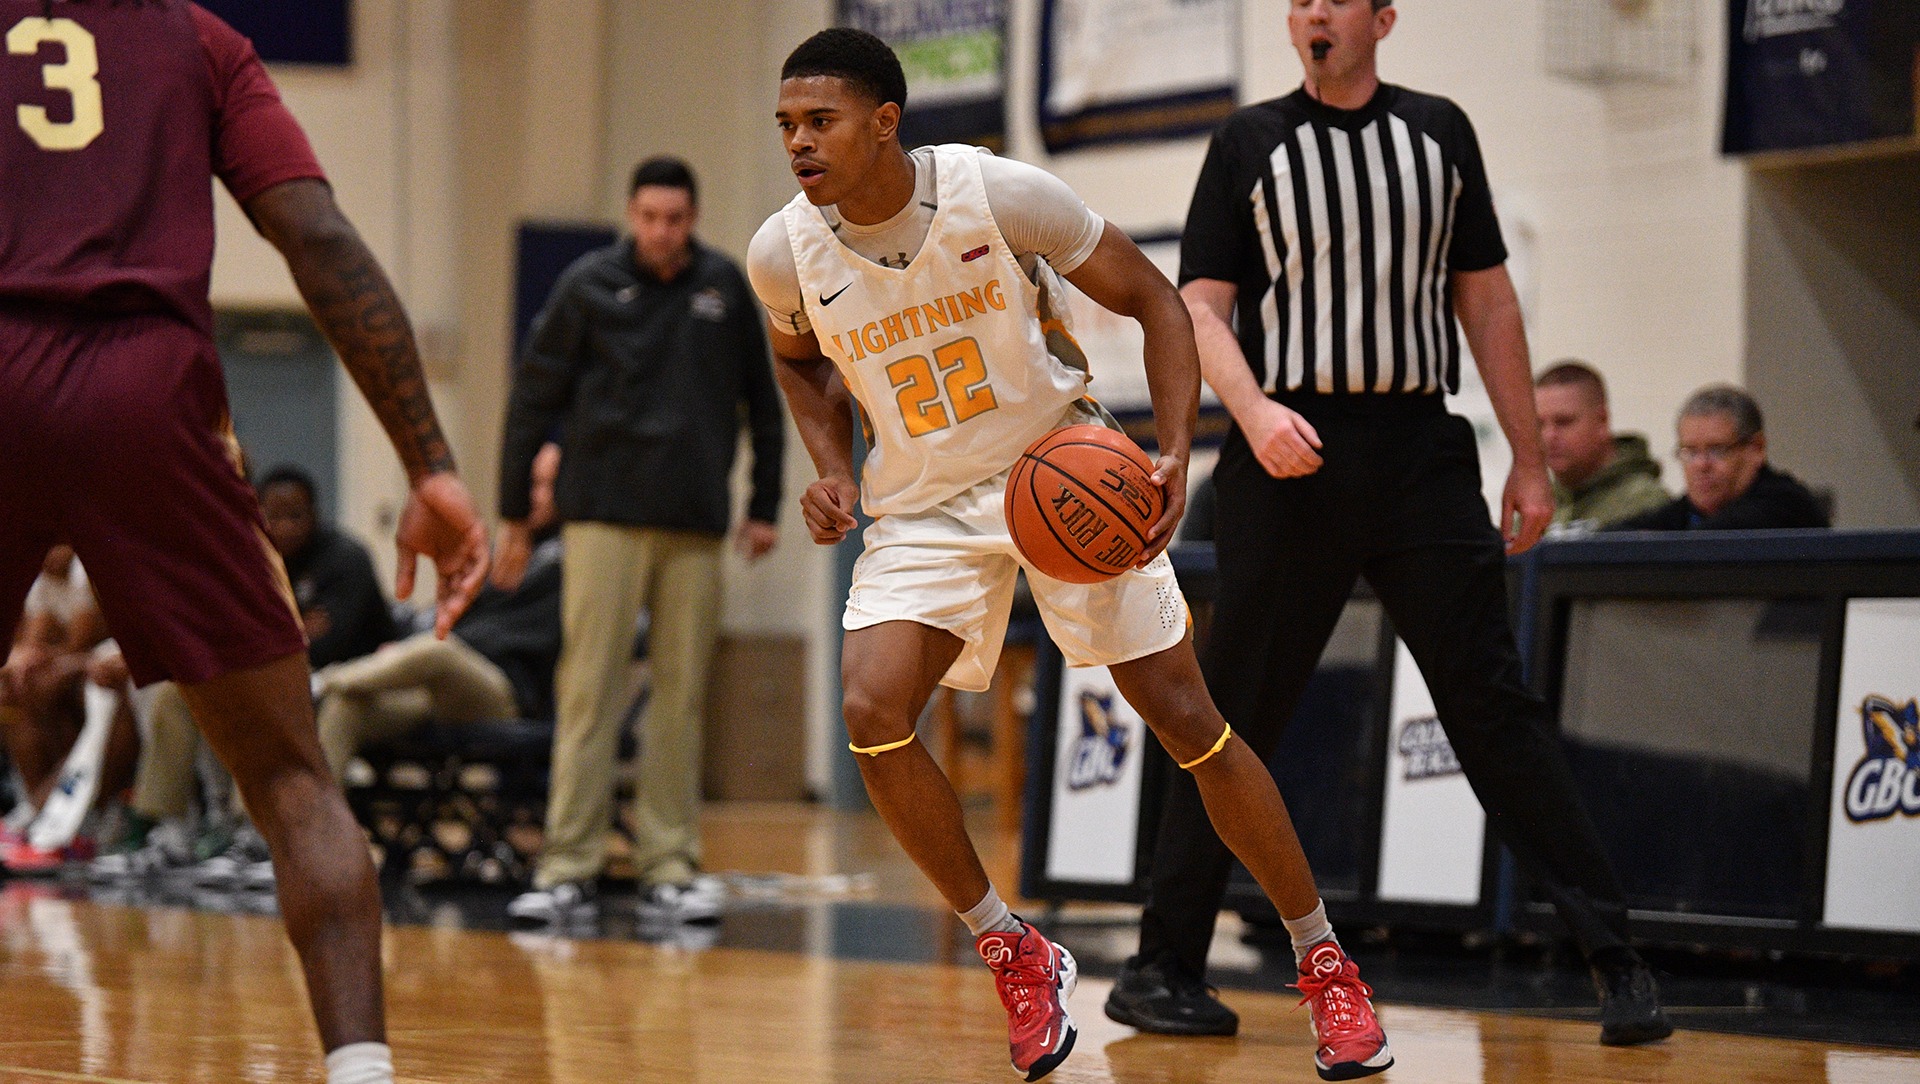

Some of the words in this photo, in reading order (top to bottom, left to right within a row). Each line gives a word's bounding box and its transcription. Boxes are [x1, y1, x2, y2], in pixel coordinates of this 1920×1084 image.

[5, 16, 105, 152] 3
[831, 279, 1007, 363] LIGHTNING
[885, 336, 999, 438] 22
[1051, 485, 1110, 550] ROCK
[1094, 533, 1139, 568] THE
